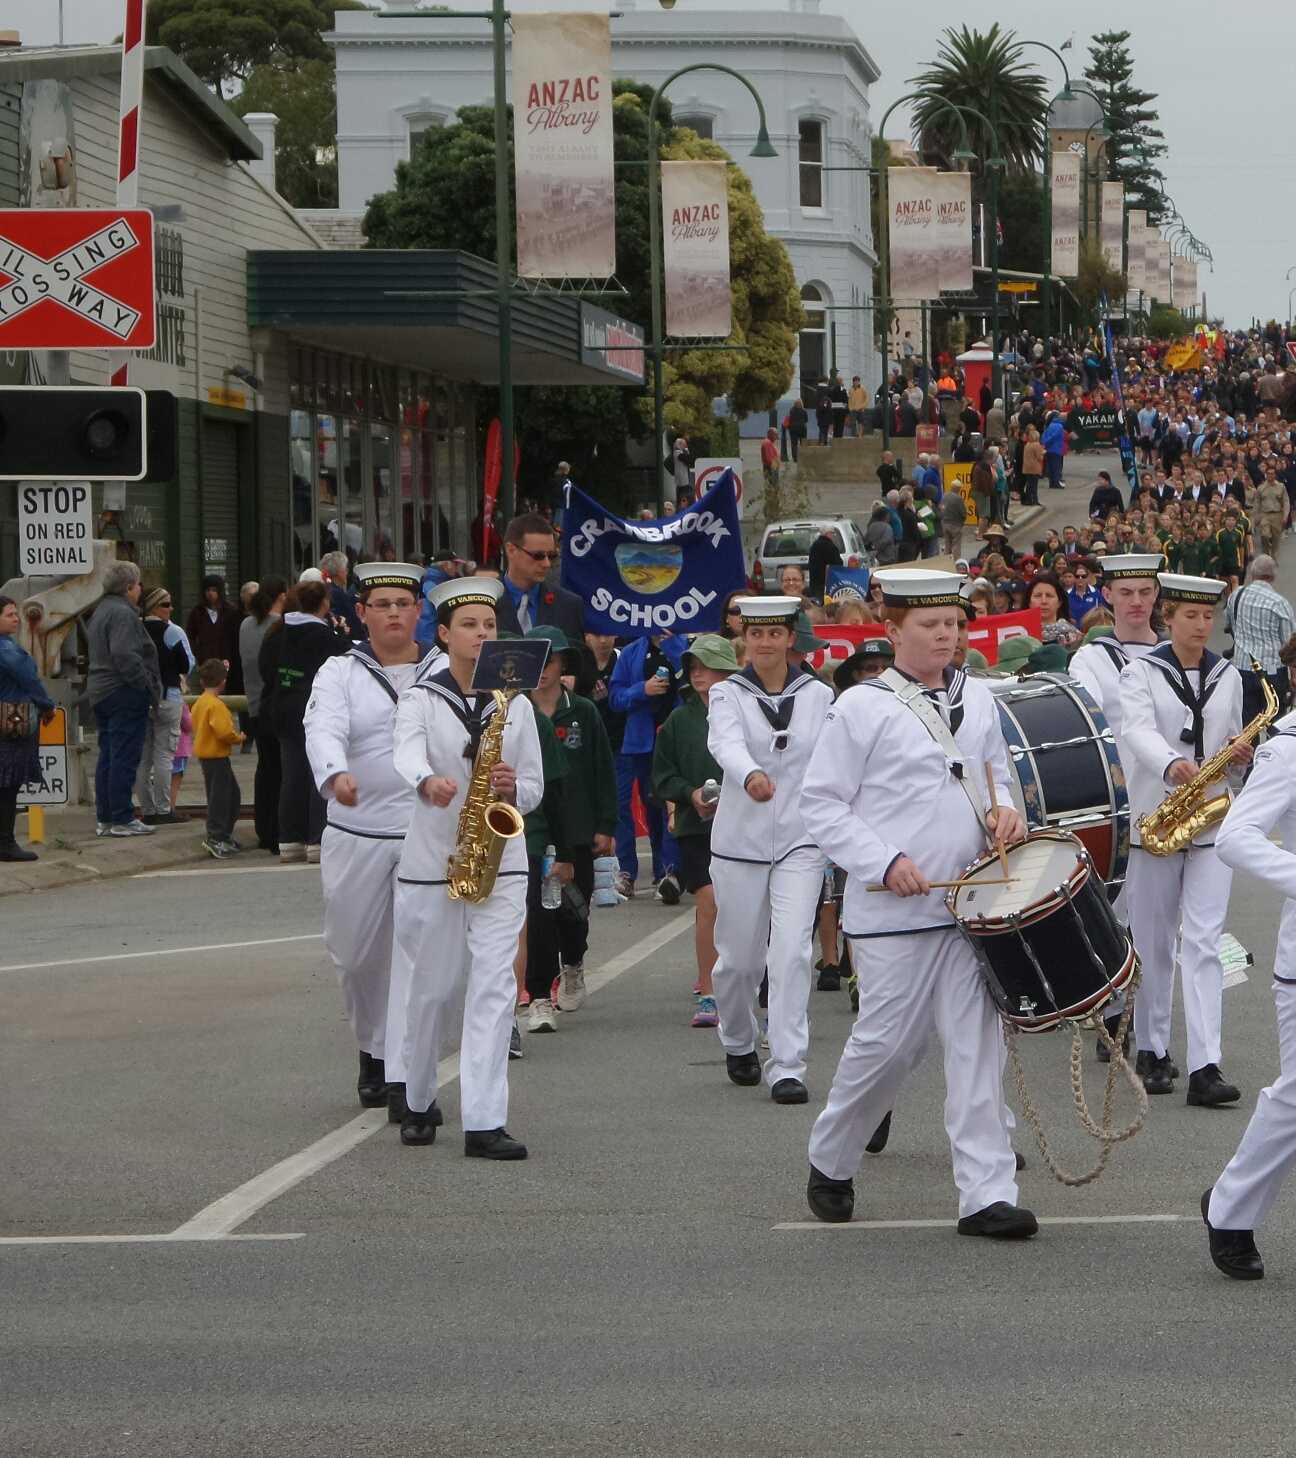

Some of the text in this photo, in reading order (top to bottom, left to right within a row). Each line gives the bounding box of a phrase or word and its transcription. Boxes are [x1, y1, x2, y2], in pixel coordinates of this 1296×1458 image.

[528, 76, 600, 108] ANZAC
[526, 101, 601, 135] Albany
[671, 204, 720, 225] ANZAC
[895, 199, 932, 216] ANZAC
[671, 223, 720, 243] Albany
[0, 229, 126, 314] OSSING
[24, 487, 87, 514] STOP
[26, 522, 86, 540] ON RED
[27, 547, 87, 565] SIGNAL
[590, 586, 718, 628] SCHOOL
